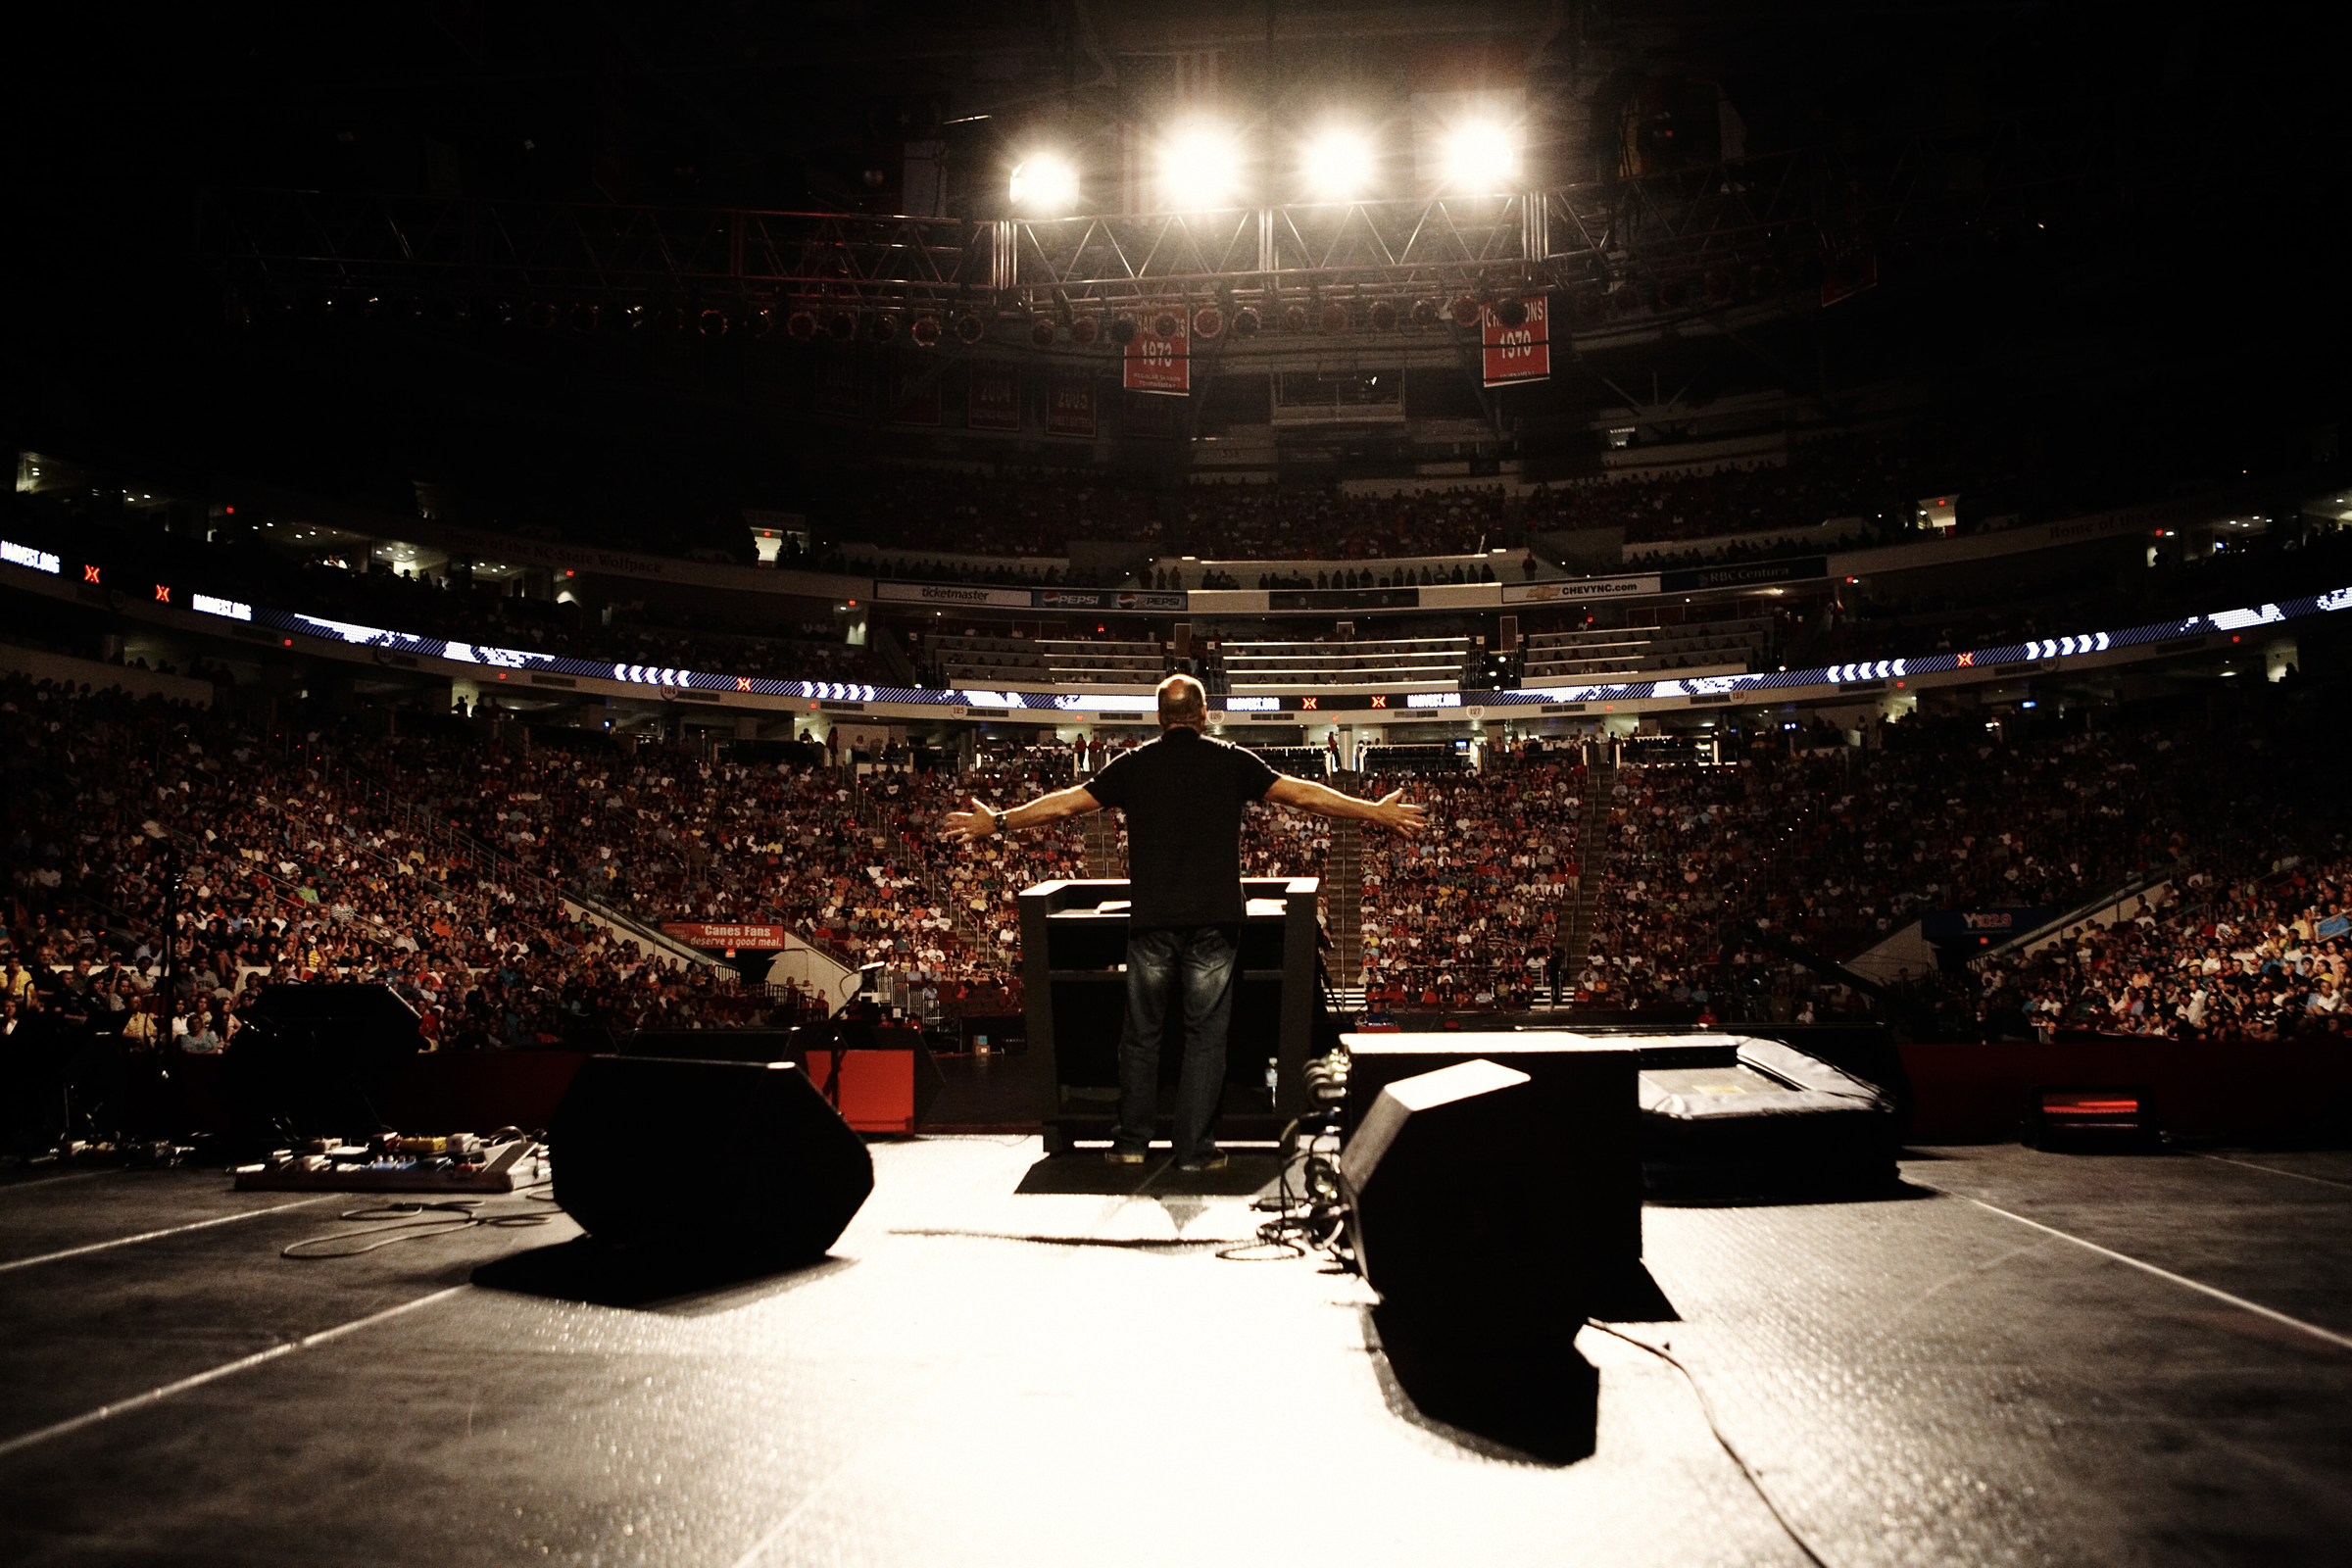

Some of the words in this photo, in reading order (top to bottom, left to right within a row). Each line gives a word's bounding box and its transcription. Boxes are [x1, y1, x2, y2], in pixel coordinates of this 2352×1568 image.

[1500, 330, 1532, 360] 1970
[2099, 517, 2115, 530] of
[2120, 513, 2144, 527] the
[444, 528, 485, 548] Home
[490, 540, 504, 550] of
[508, 541, 530, 555] the
[598, 554, 662, 573] Wolfpack
[1710, 569, 1737, 583] RBC
[1739, 565, 1789, 579] Centura
[921, 587, 989, 601] ticketmaster
[1562, 582, 1638, 596] CHEVYNC.com
[1057, 595, 1100, 605] PEPSI
[1147, 597, 1180, 606] PEPSI
[1962, 912, 2012, 929] Y102.9
[744, 925, 771, 937] Fans
[690, 935, 725, 946] deserve
[735, 936, 757, 948] good
[758, 937, 782, 948] meal.
